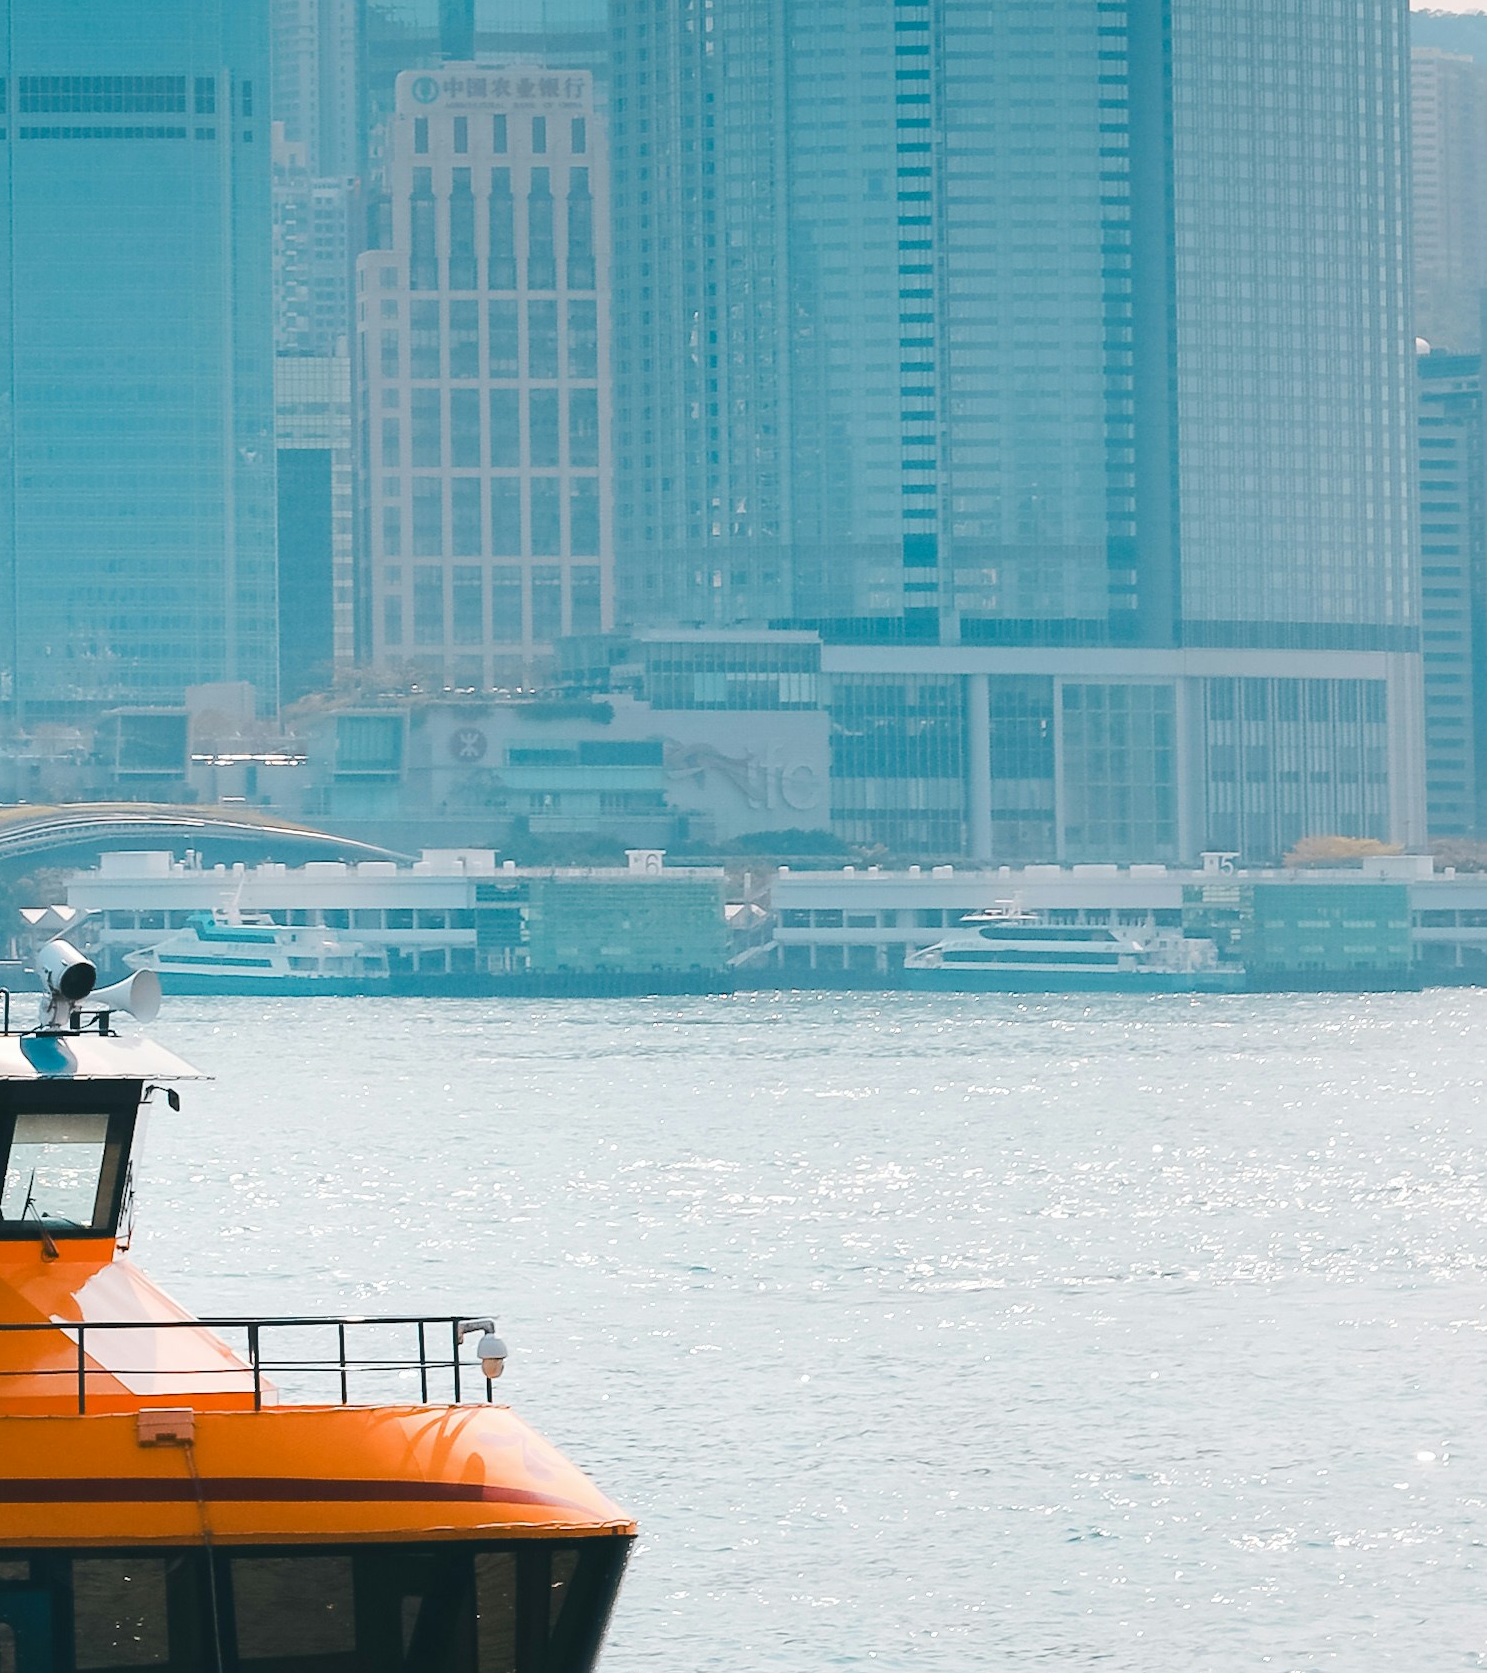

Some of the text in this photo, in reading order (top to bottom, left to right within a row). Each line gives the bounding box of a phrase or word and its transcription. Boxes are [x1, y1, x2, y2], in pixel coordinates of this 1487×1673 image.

[442, 76, 584, 99] 中国农业银行
[645, 853, 659, 876] 6
[1220, 856, 1234, 877] 5
